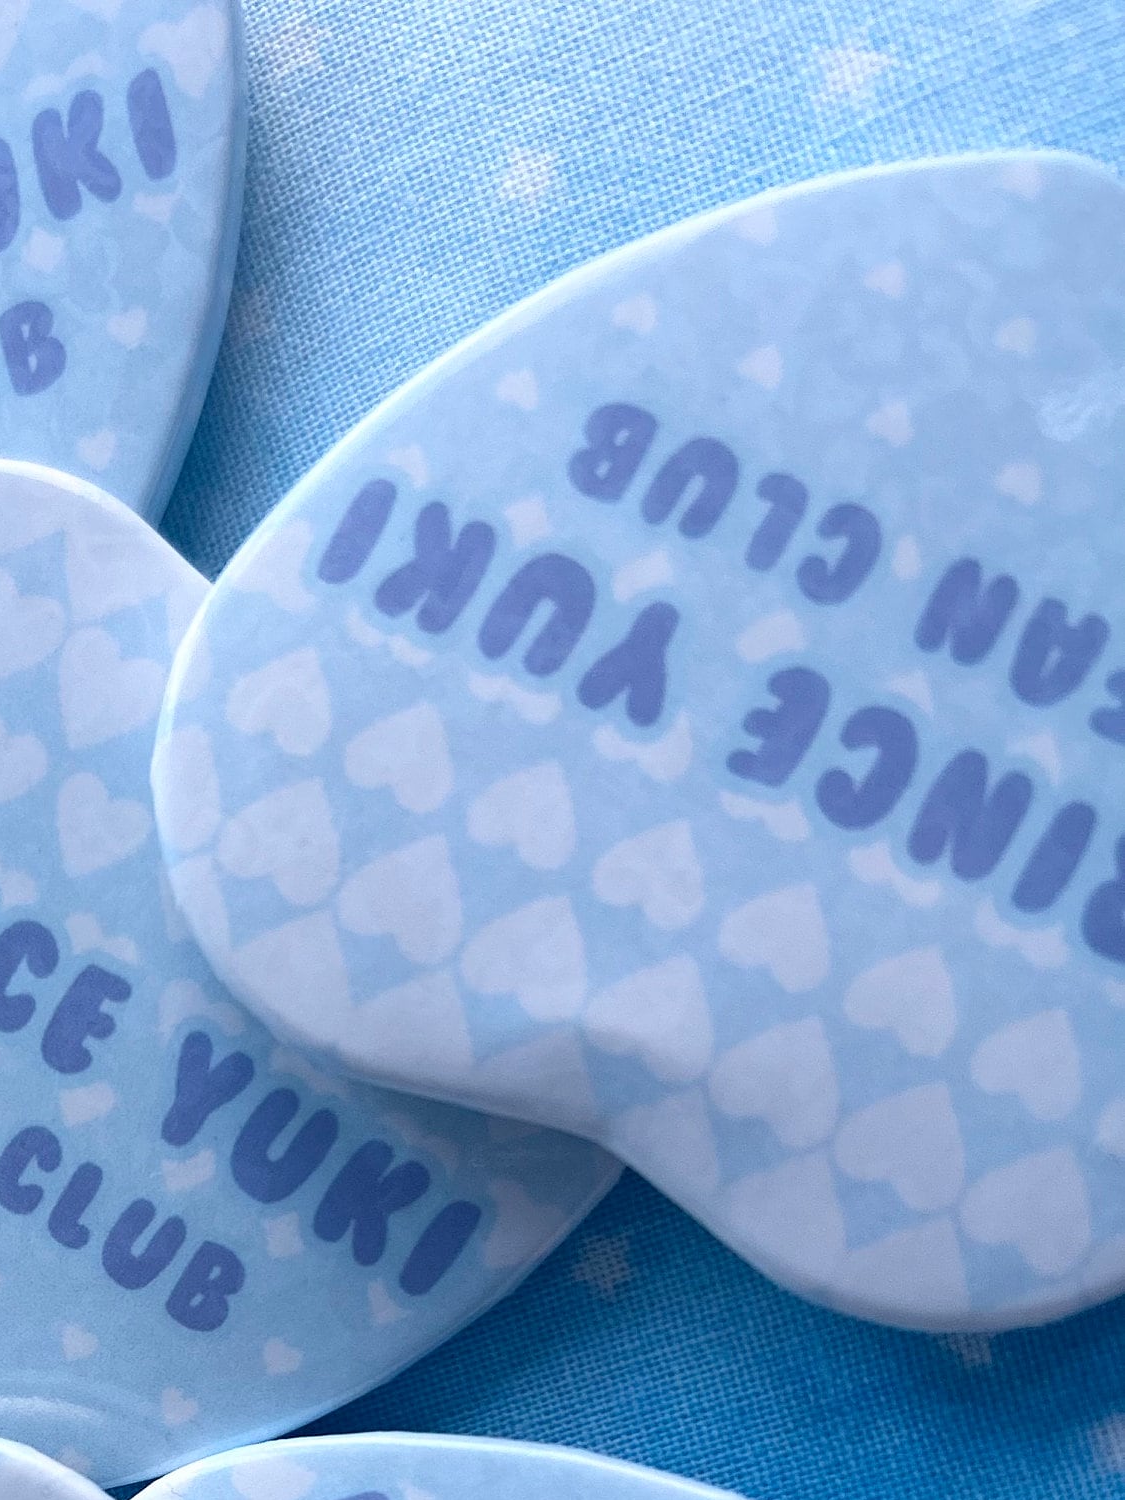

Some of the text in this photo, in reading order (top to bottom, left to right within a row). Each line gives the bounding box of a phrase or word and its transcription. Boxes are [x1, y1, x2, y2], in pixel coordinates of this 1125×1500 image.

[567, 403, 882, 605] CLUB
[317, 479, 1125, 963] INCE YUKI
[161, 1032, 482, 1296] YUKI
